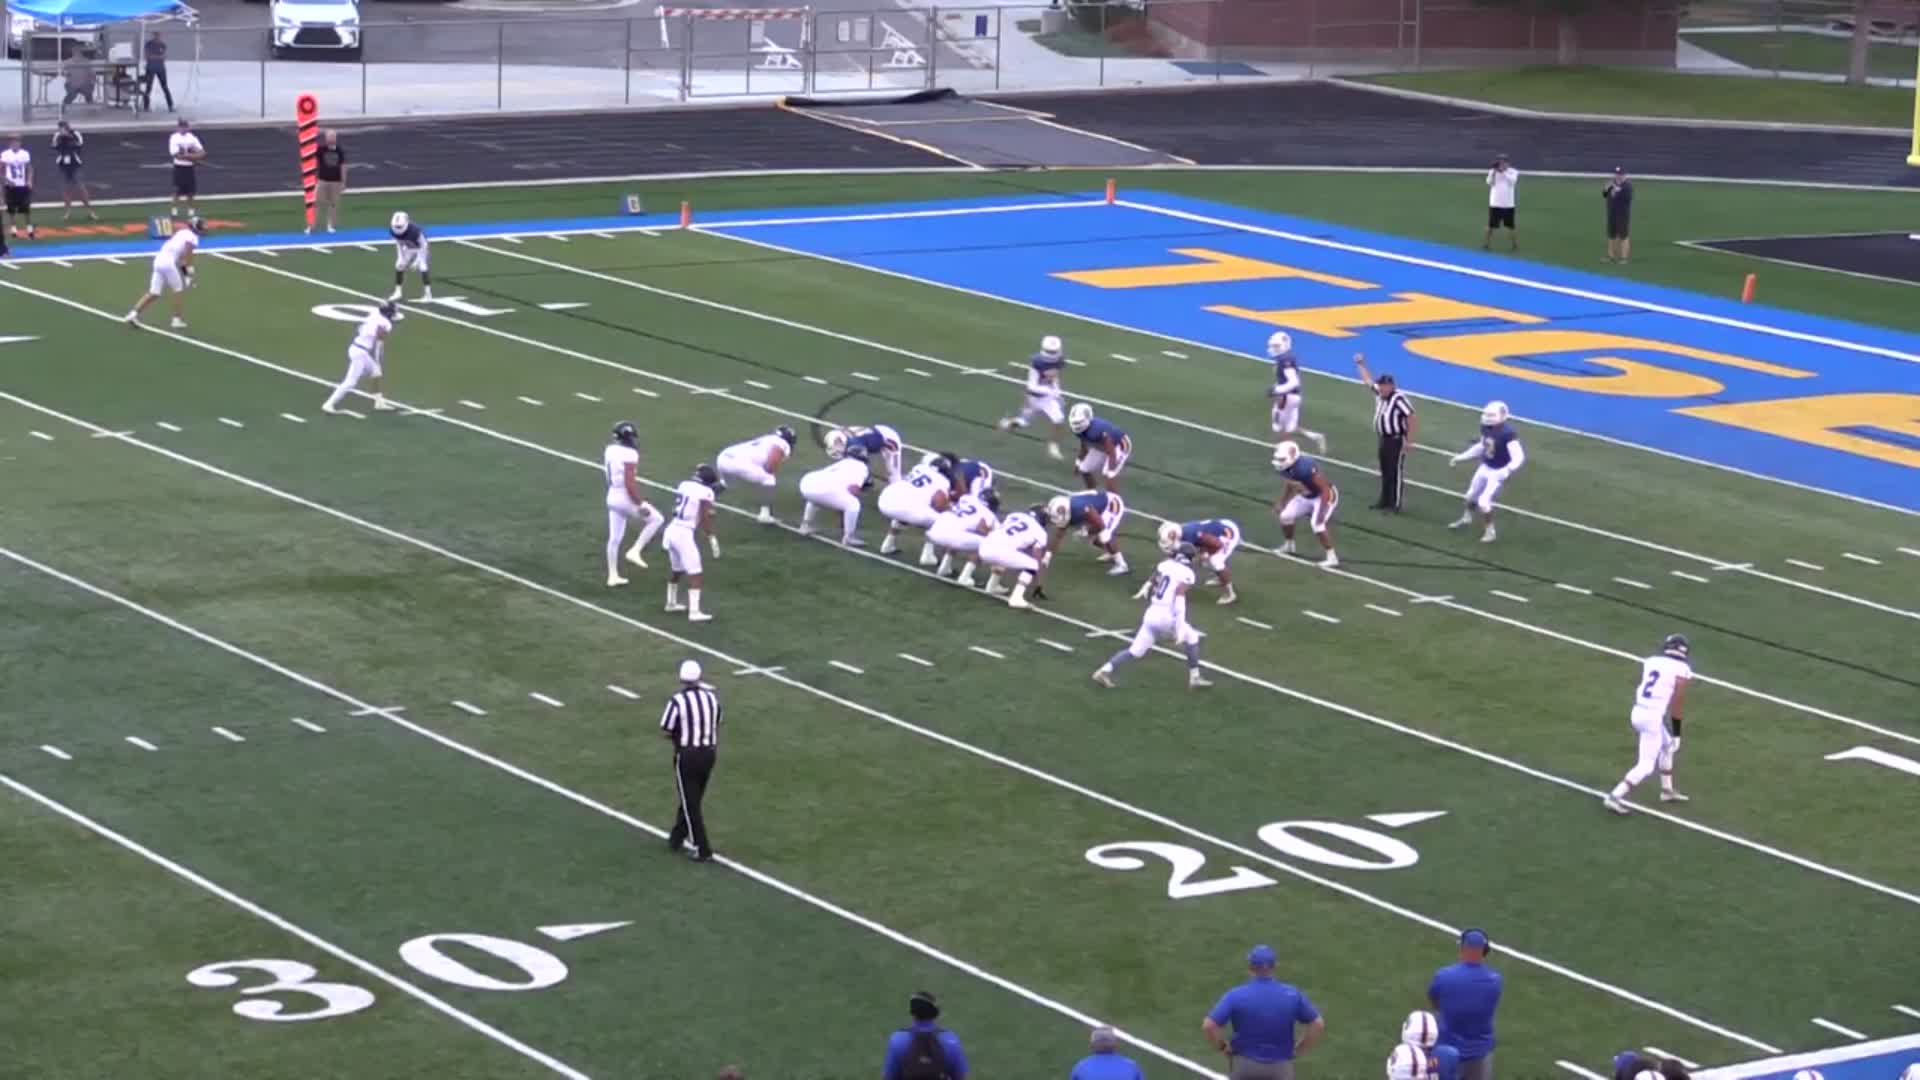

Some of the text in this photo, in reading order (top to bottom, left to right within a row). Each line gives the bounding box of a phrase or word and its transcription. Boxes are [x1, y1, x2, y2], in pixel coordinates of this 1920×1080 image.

[155, 217, 172, 236] 10
[1641, 669, 1661, 699] 2
[1085, 820, 1420, 900] 20
[185, 932, 569, 1021] 30
